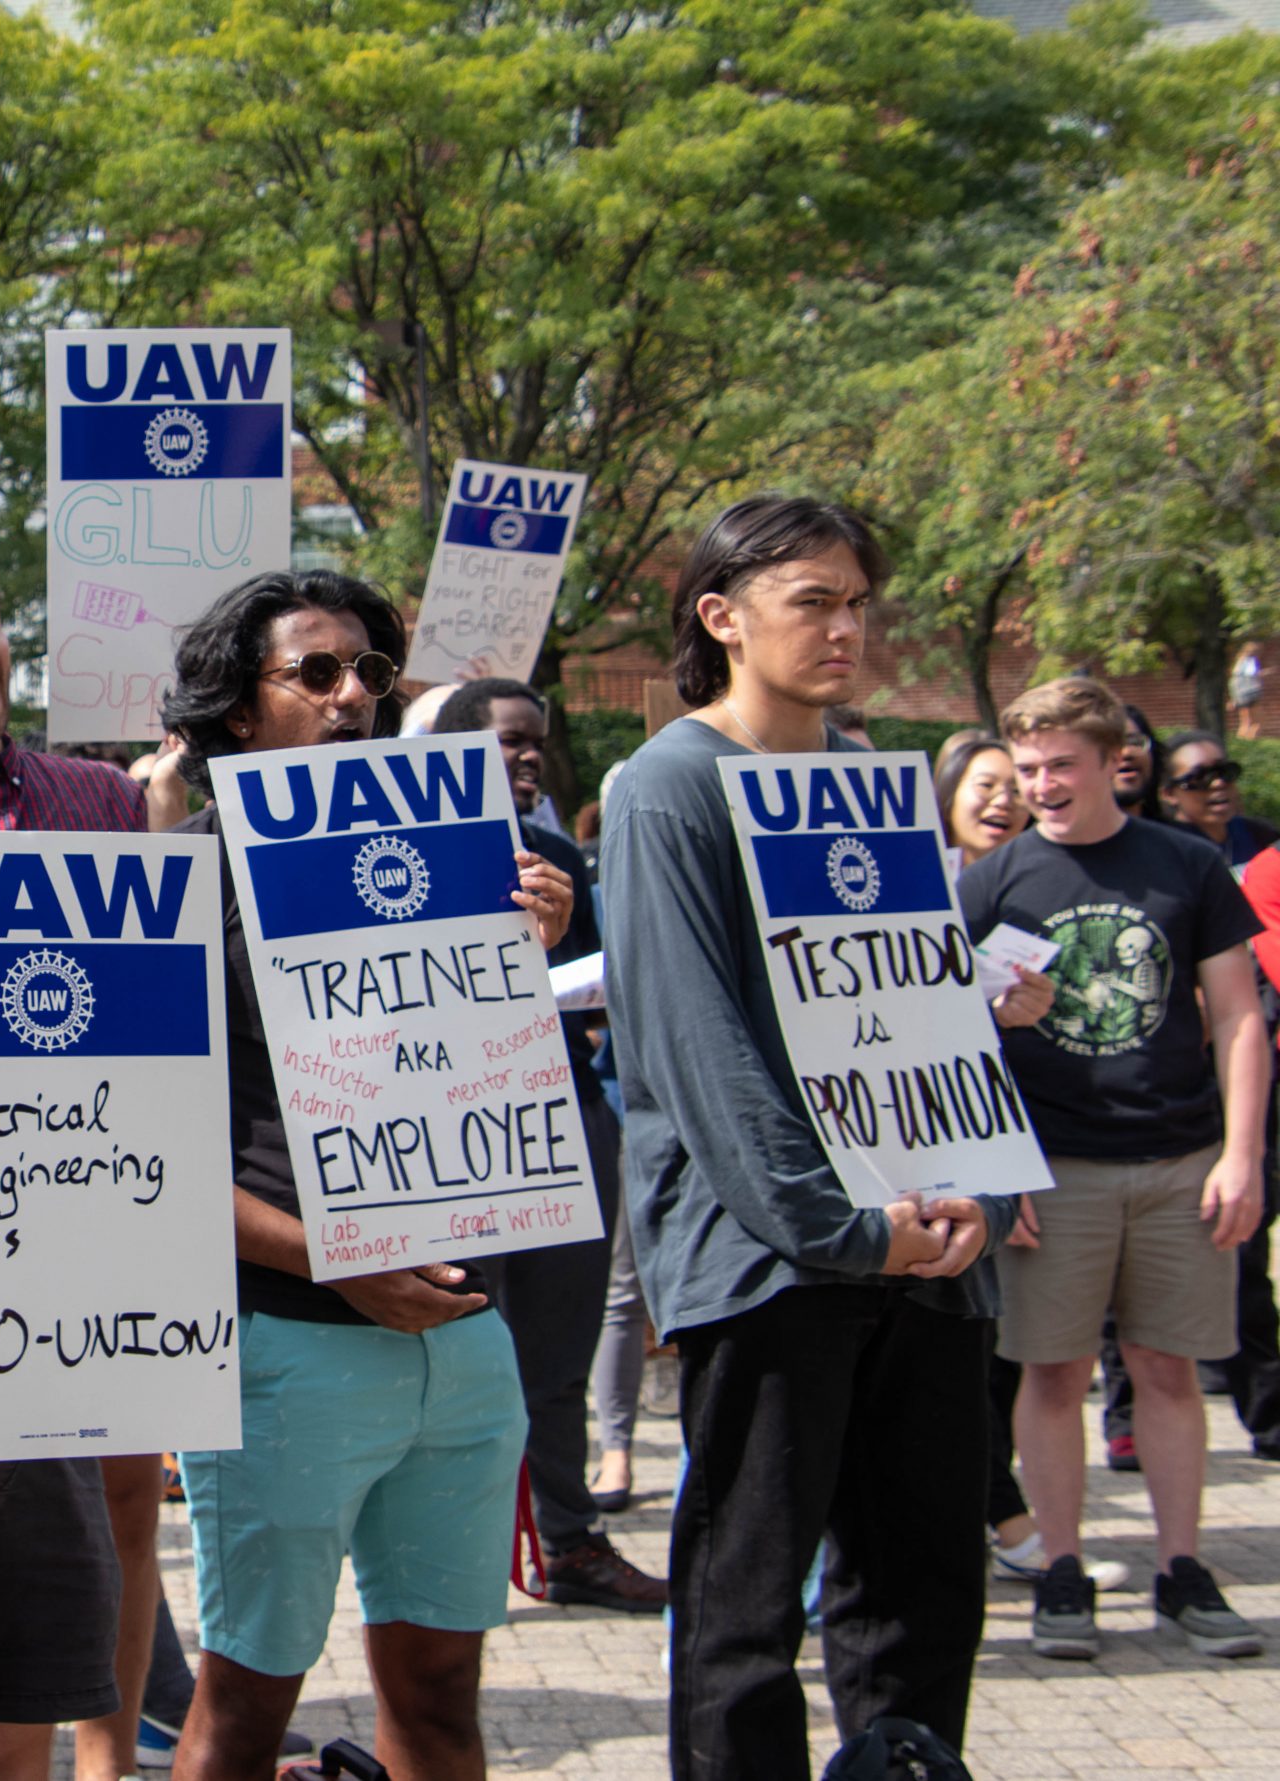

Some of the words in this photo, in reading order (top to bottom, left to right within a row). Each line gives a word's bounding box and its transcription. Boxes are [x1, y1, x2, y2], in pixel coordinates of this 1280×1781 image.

[66, 343, 277, 403] UAW
[162, 434, 191, 451] UAW
[458, 469, 574, 512] UAW
[54, 481, 253, 570] G.L.U.
[442, 549, 517, 582] FIGHT
[481, 584, 552, 616] RIGHT
[52, 633, 178, 736] Supp
[236, 748, 486, 841] UAW
[739, 766, 917, 832] UAW
[374, 867, 407, 889] UAW
[1042, 907, 1076, 928] YOU
[271, 930, 536, 1020] "TRAINEE"
[766, 923, 975, 1003] TESTUDO
[27, 989, 68, 1012] UAW
[328, 1027, 400, 1059] lecturer
[482, 1010, 560, 1063] Researcher
[851, 1002, 892, 1048] is
[282, 1045, 385, 1101] Instructor
[395, 1040, 453, 1073] AKA
[520, 1056, 571, 1093] Grader
[287, 1088, 356, 1124] Admin
[800, 1050, 1028, 1151] PRO-UNION
[312, 1097, 579, 1196] EMPLOYEE
[320, 1215, 361, 1246] Lab
[449, 1204, 500, 1239] Grant
